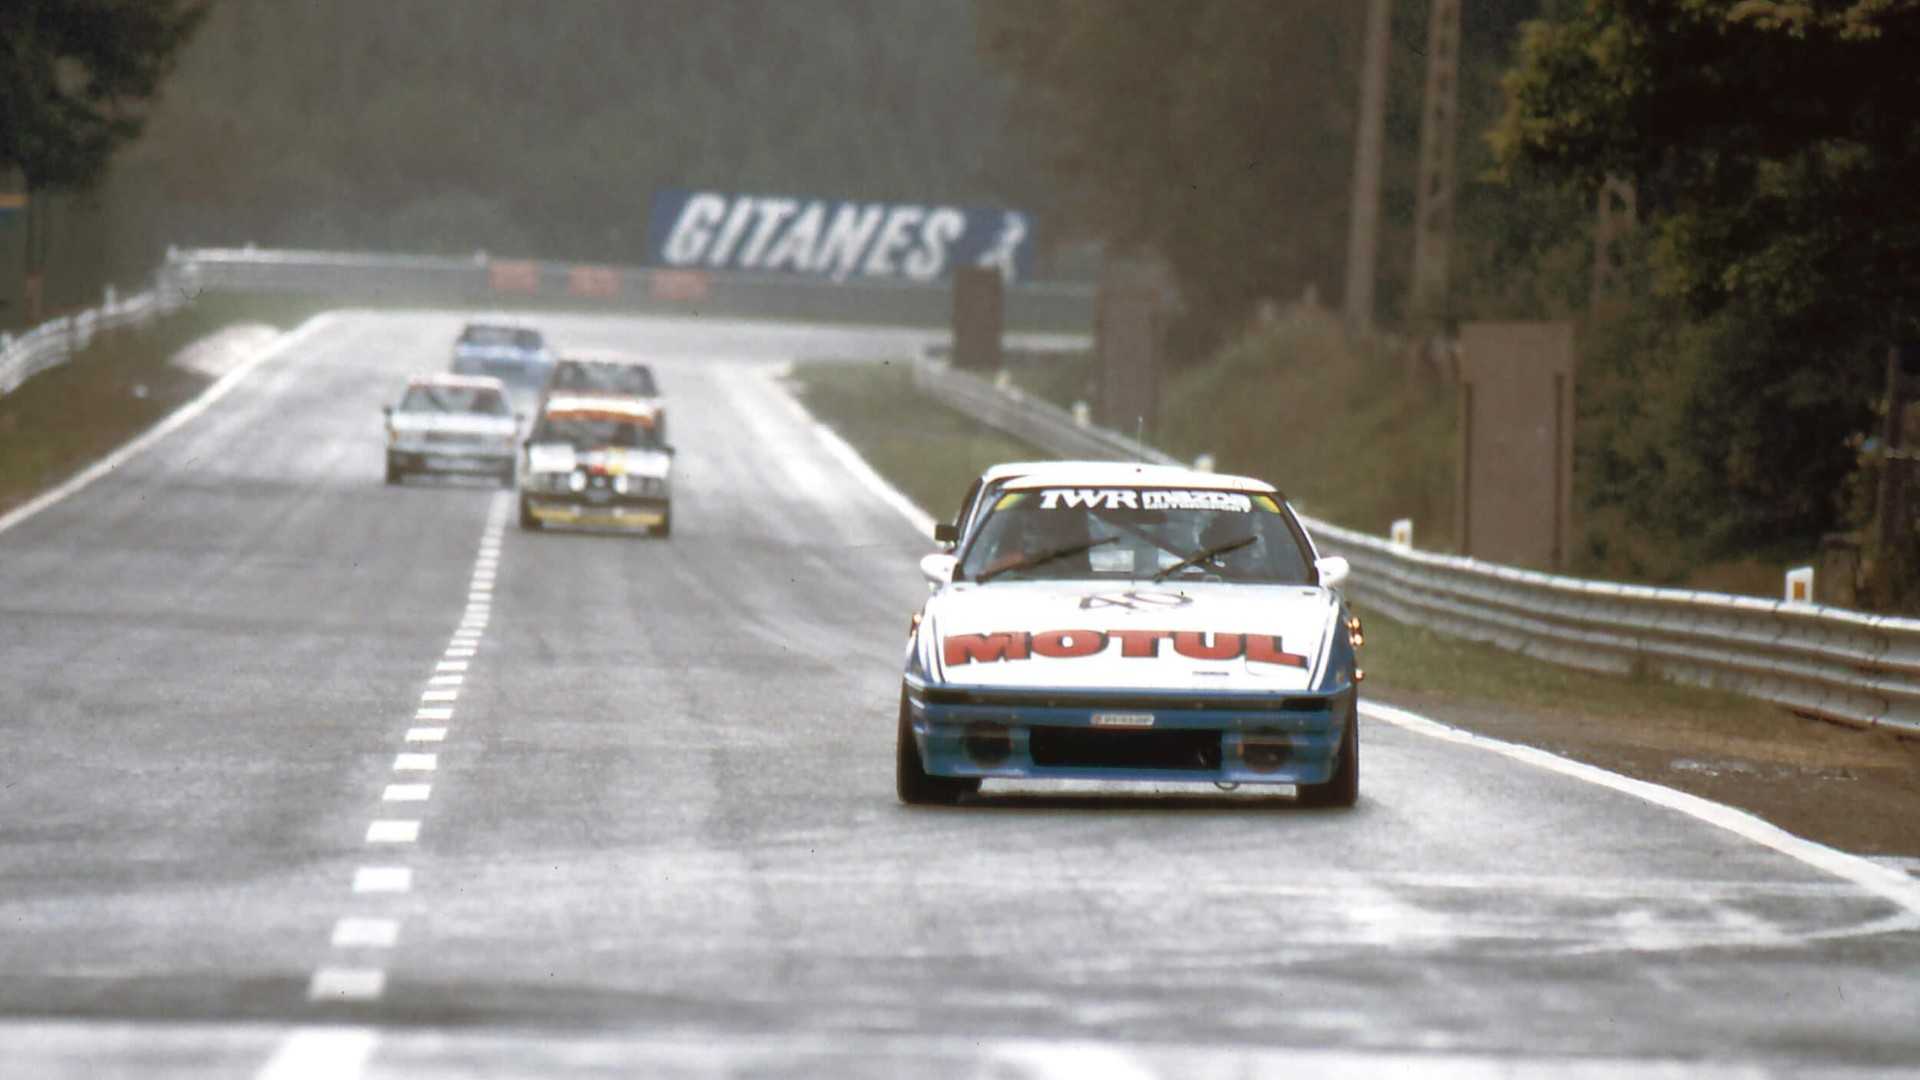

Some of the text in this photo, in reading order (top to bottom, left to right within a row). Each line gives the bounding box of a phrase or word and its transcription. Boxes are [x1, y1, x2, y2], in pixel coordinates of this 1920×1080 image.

[662, 192, 966, 284] GITANES
[1040, 489, 1139, 510] TWR
[944, 629, 1308, 668] MOTUL
